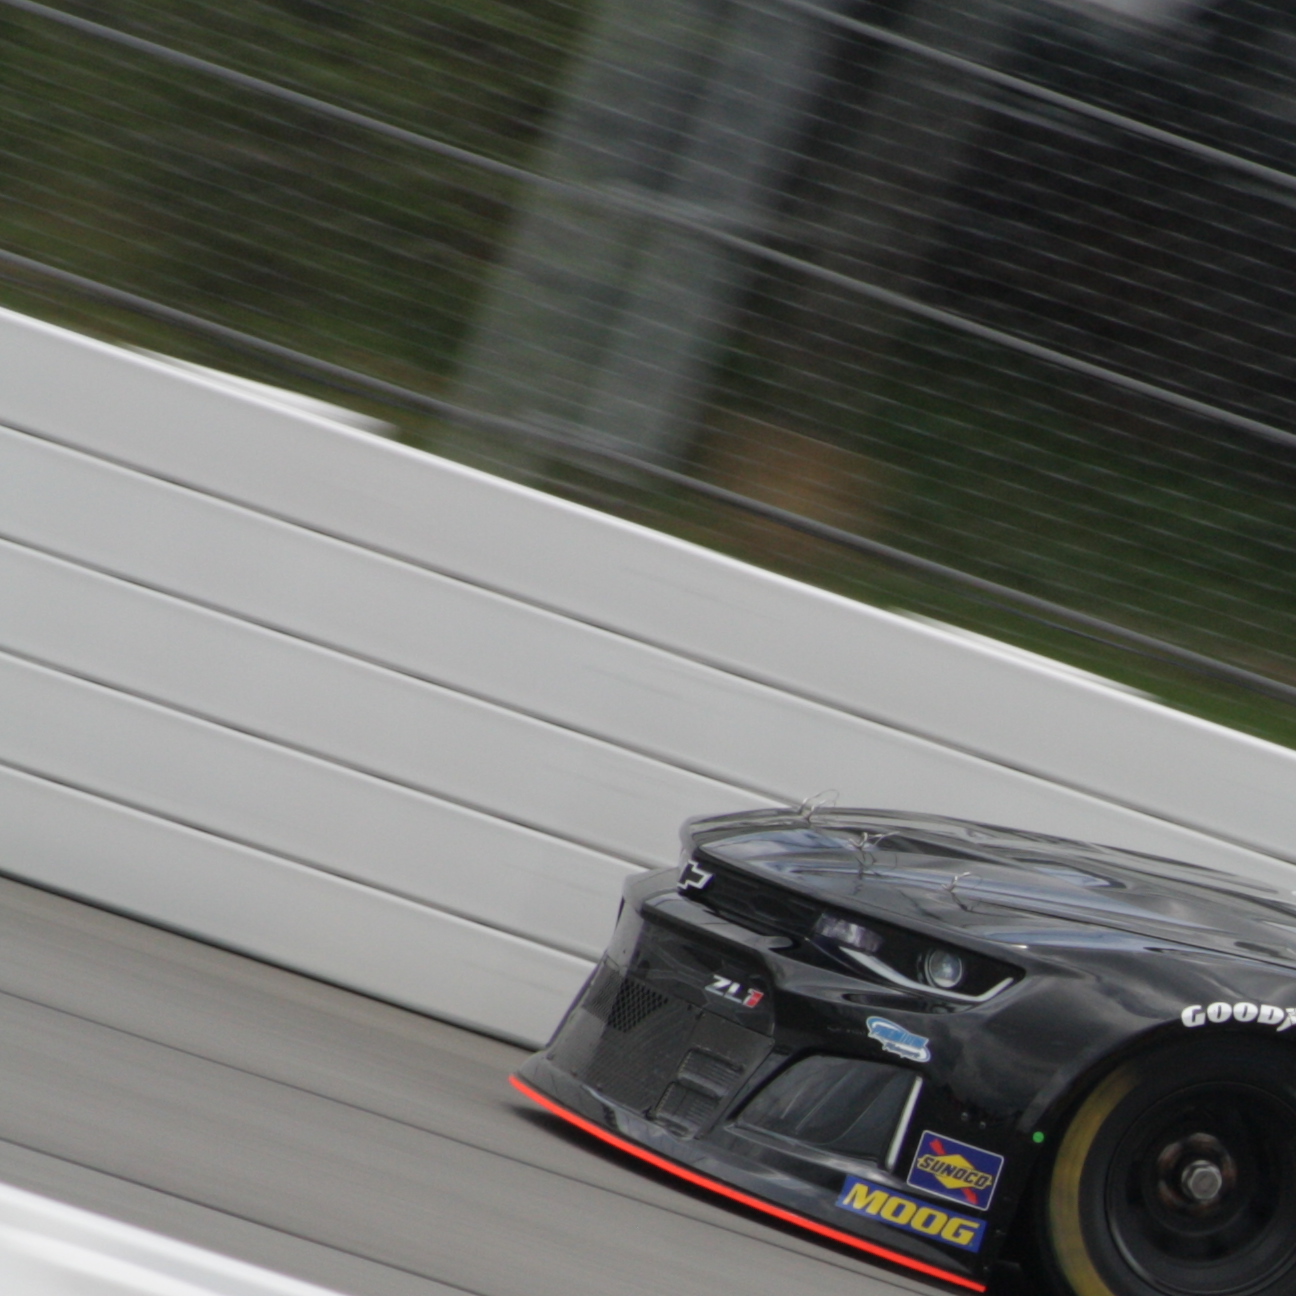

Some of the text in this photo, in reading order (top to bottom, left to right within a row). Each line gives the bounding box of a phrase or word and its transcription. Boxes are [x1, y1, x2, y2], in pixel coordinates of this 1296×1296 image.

[705, 974, 764, 1009] ZL1
[918, 1156, 989, 1189] SUNOCO
[842, 1183, 980, 1246] MOOG
